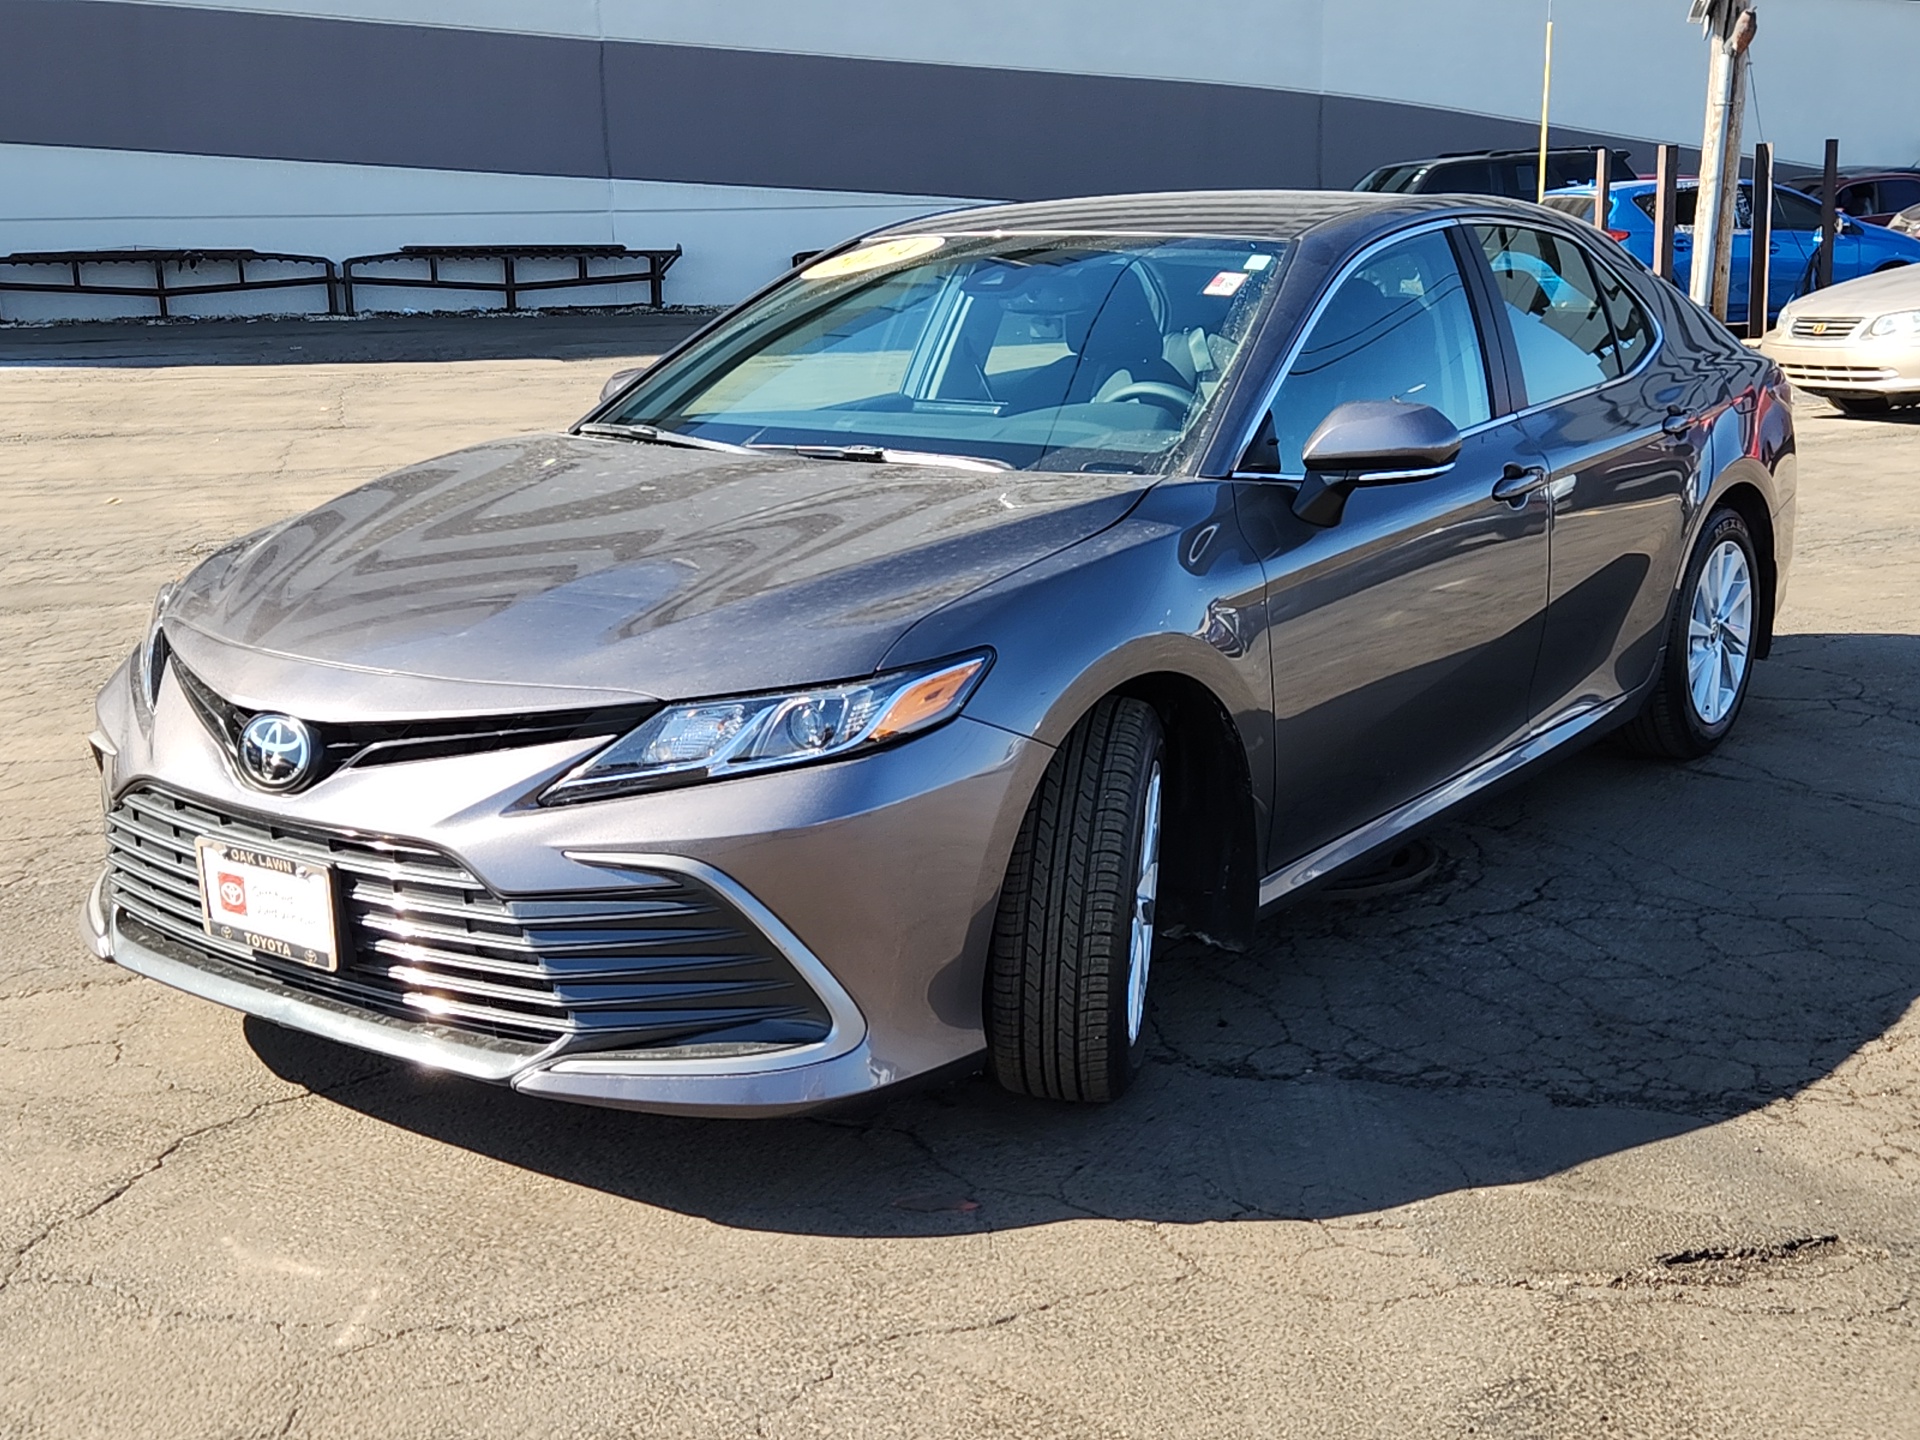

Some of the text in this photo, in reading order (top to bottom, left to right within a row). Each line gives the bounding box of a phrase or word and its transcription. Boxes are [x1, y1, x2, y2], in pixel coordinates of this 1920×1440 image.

[1714, 518, 1748, 538] NEXEN
[231, 849, 292, 873] OAK LAWN
[244, 932, 291, 957] TOYOTA
